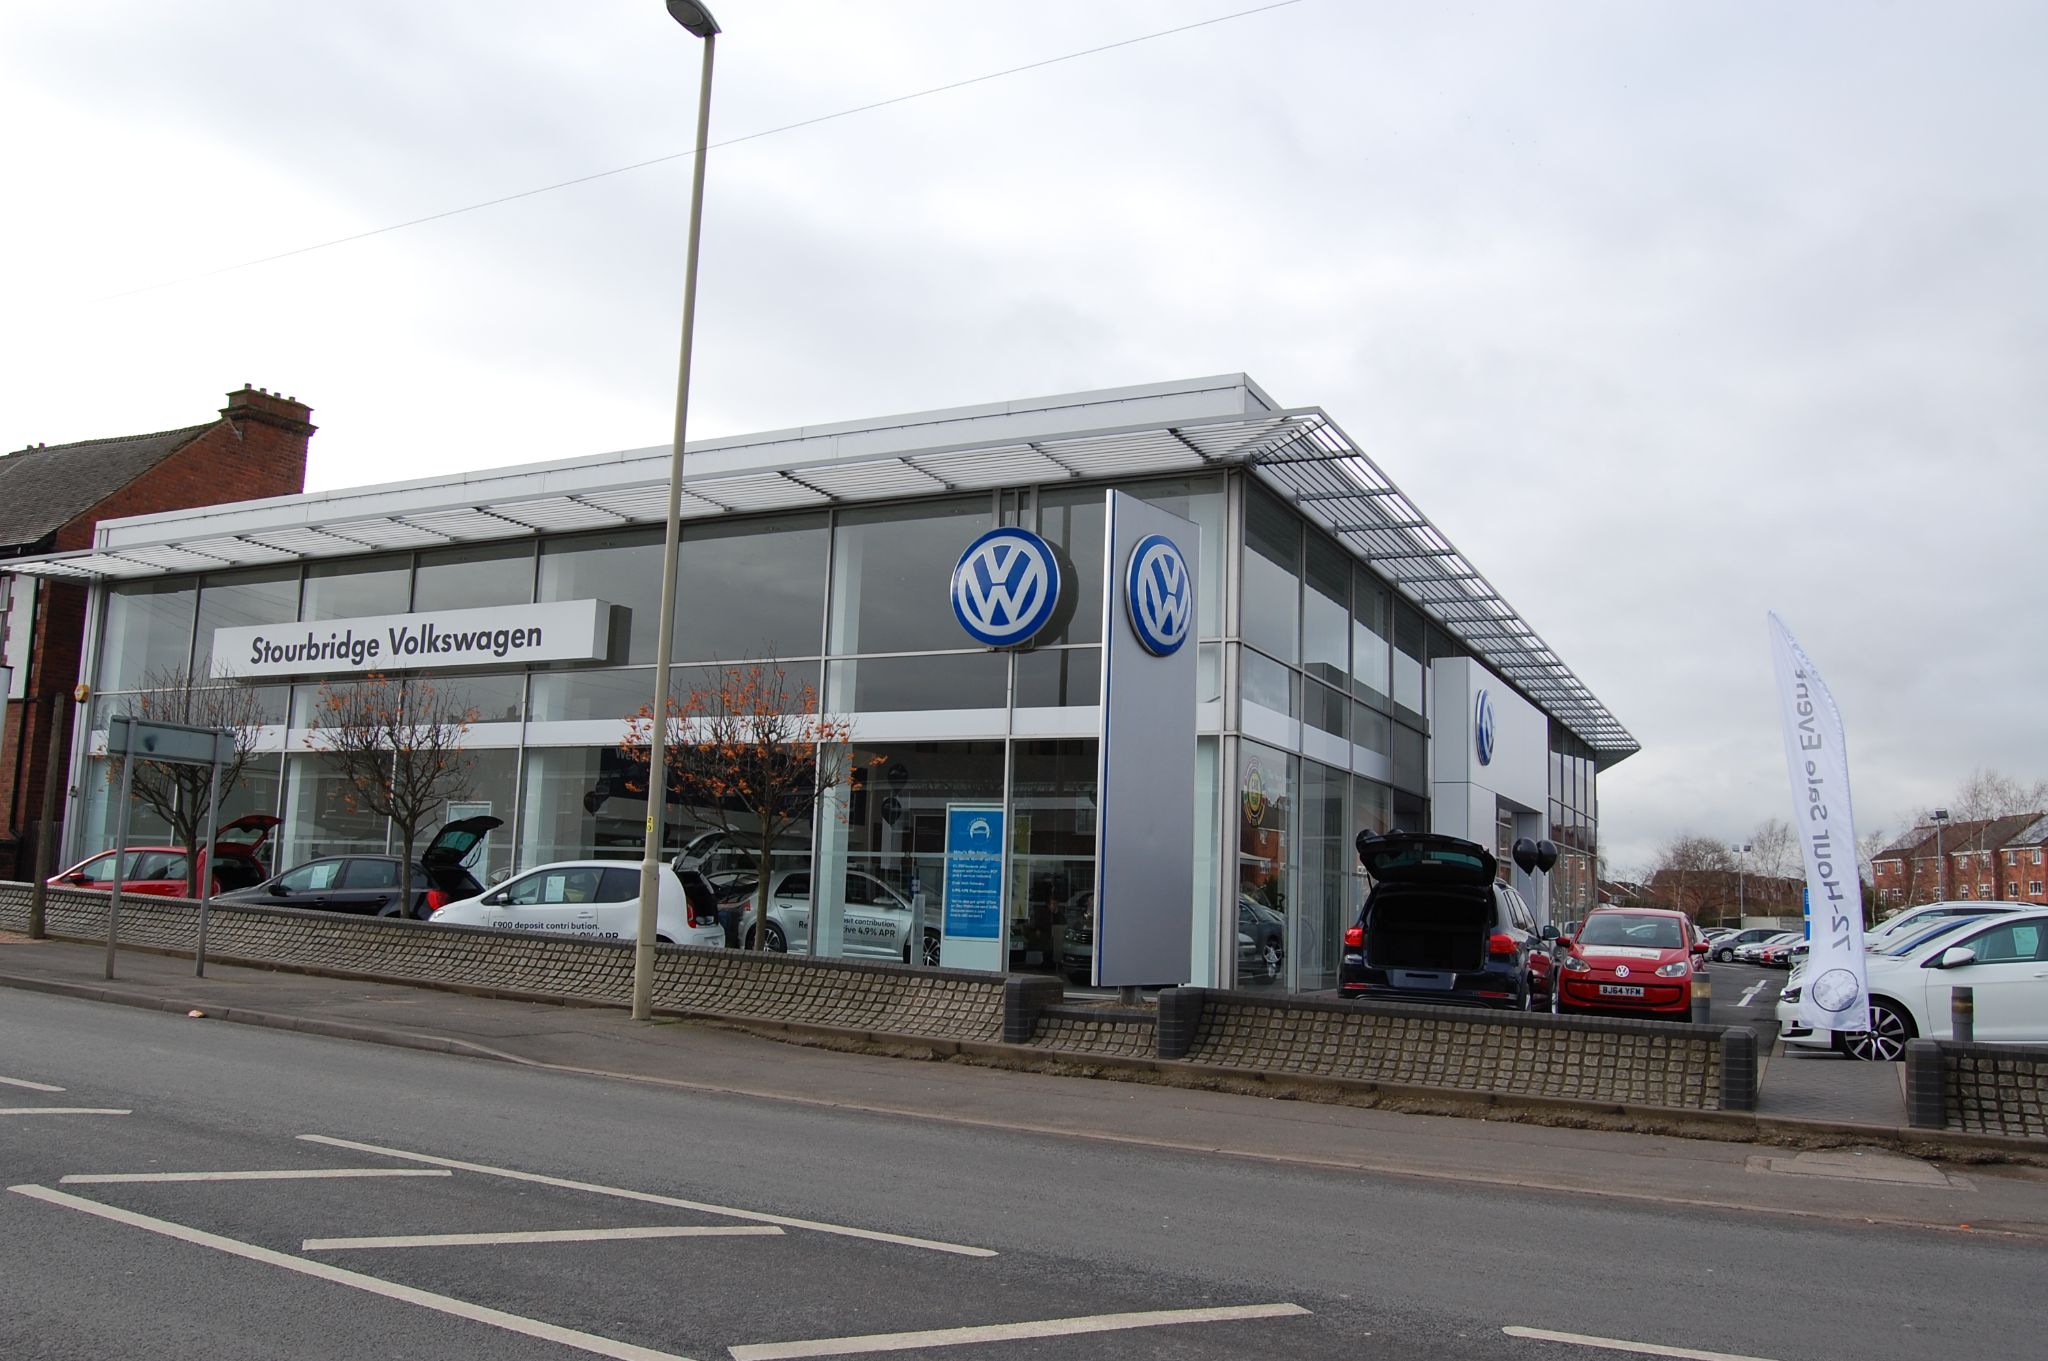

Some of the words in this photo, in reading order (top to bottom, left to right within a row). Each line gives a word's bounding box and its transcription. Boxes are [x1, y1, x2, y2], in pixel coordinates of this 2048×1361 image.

[250, 629, 380, 666] Stourbridge
[388, 623, 543, 657] Volkswagen
[514, 921, 544, 930] deposit
[878, 929, 896, 938] APR
